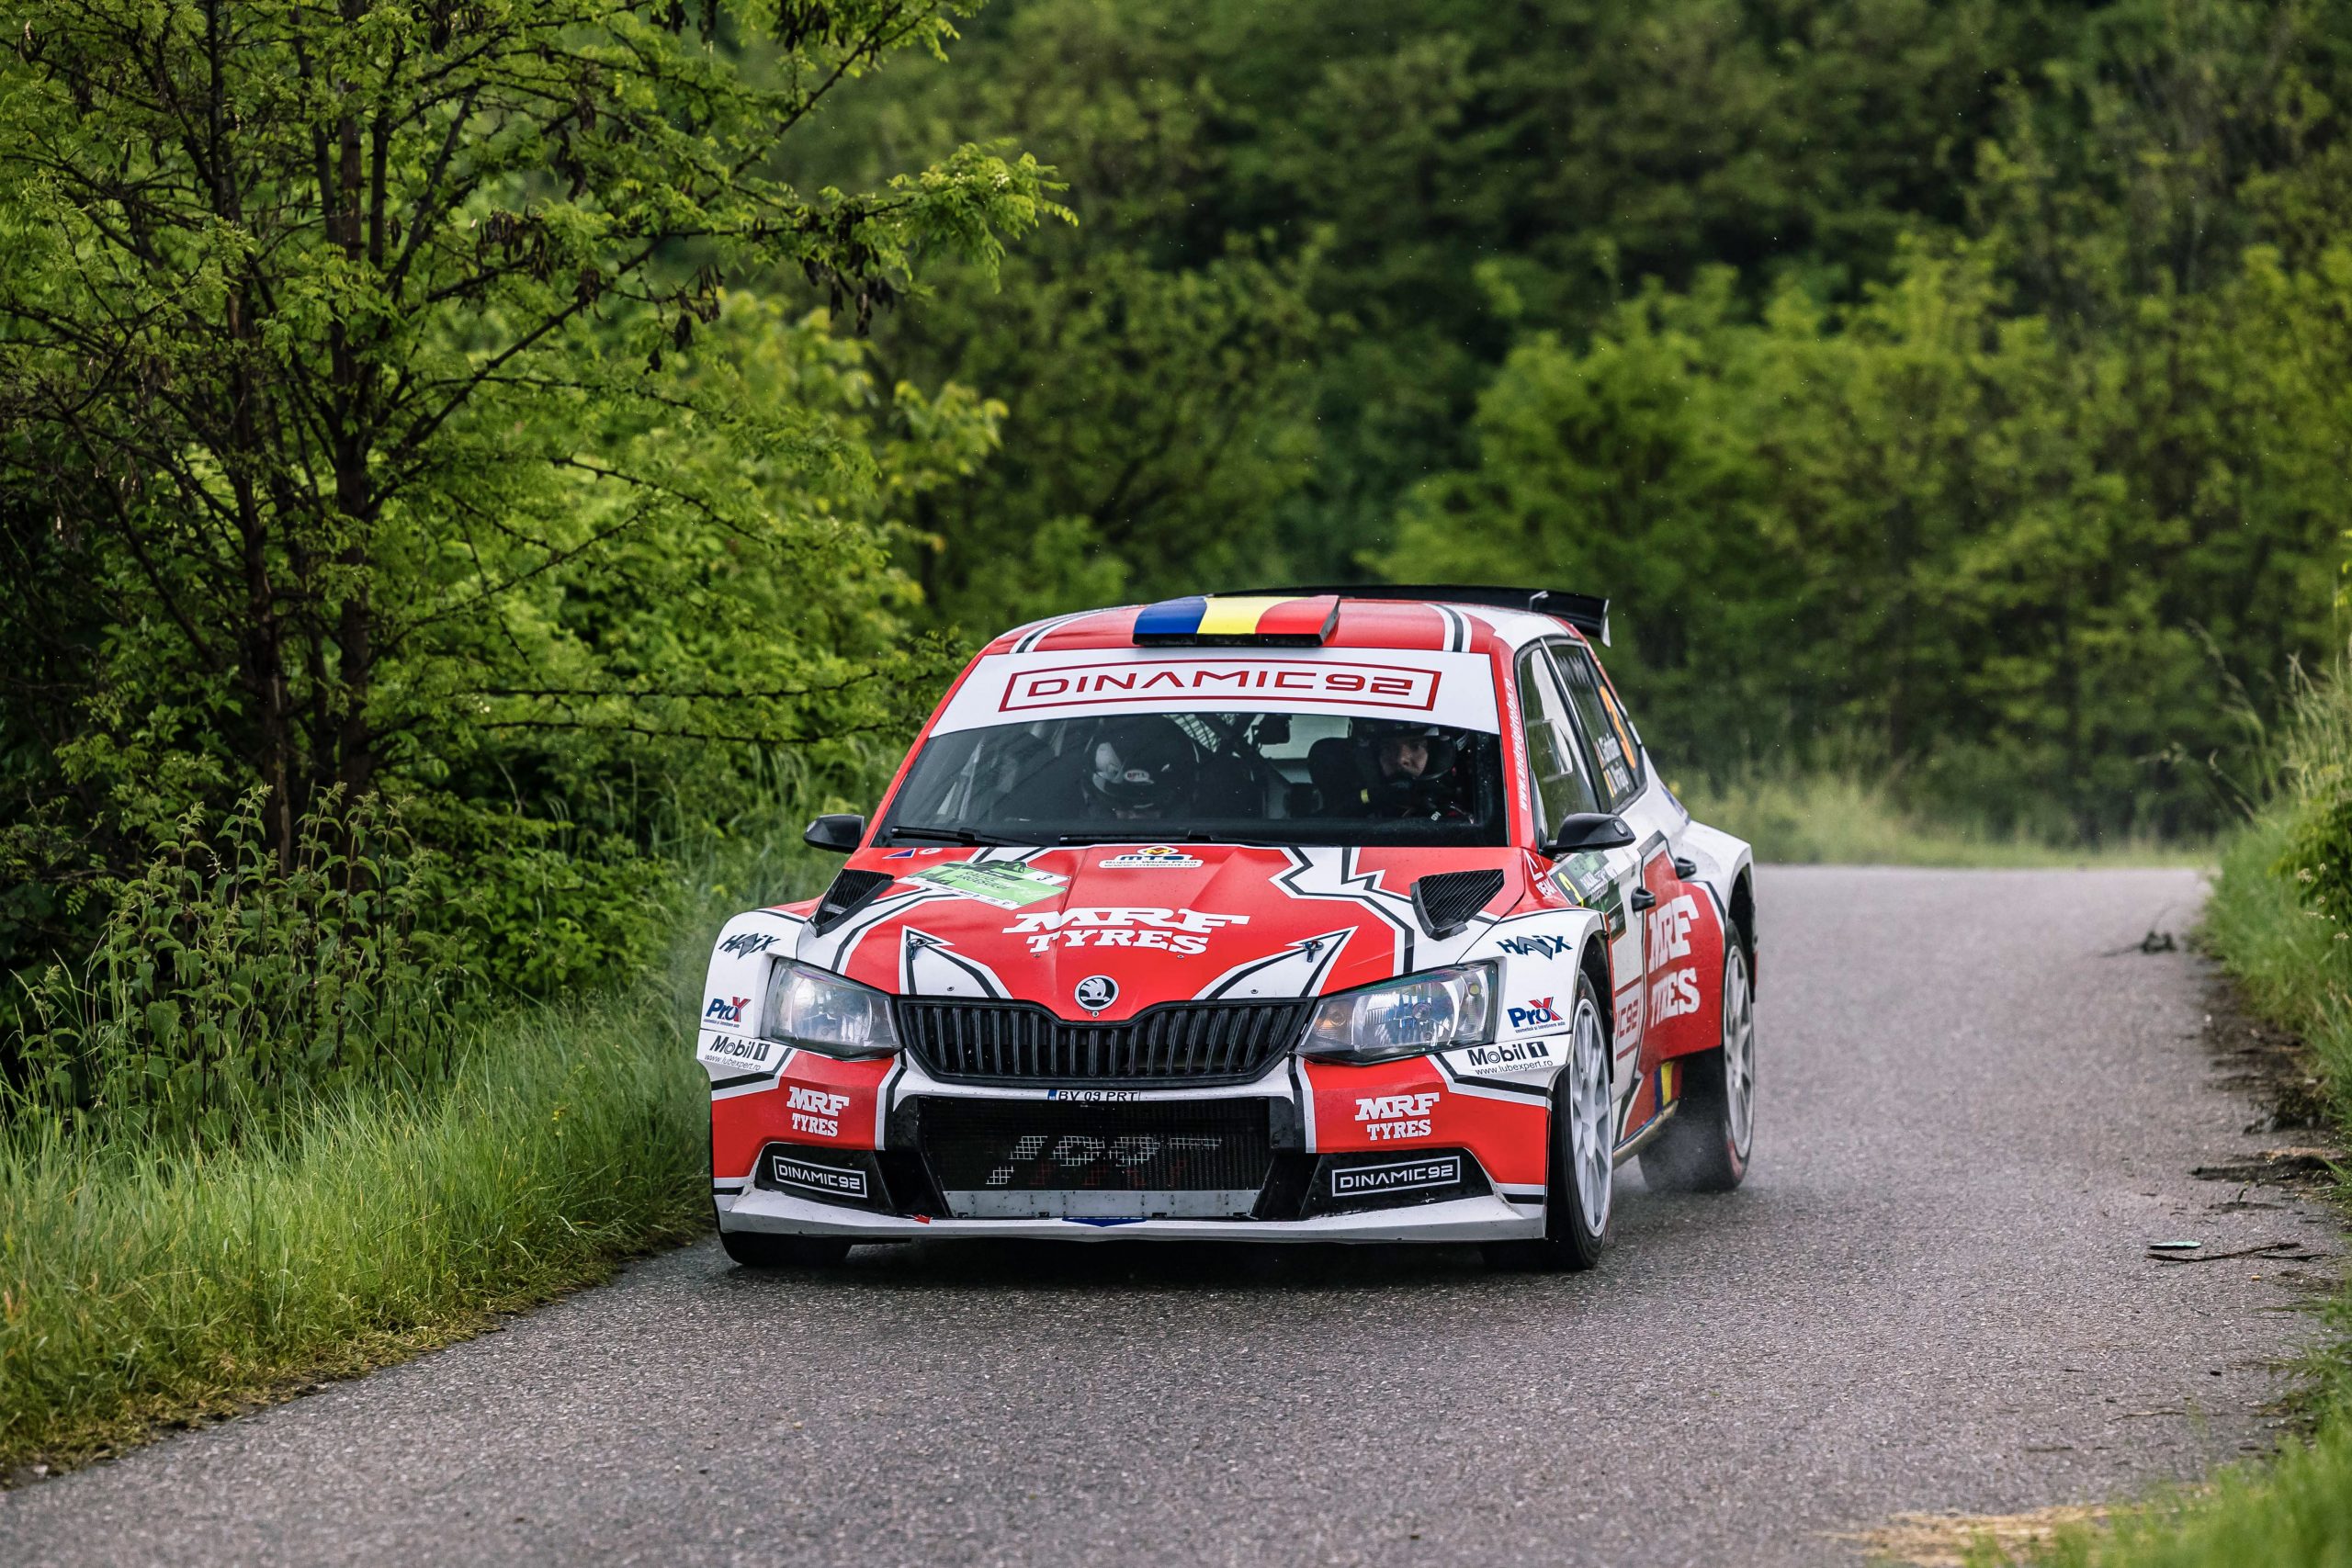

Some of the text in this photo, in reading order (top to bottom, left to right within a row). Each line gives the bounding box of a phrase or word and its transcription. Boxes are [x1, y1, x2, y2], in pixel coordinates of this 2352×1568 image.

[1026, 671, 1414, 698] DINAMIC92
[1001, 907, 1250, 934] MRF
[1026, 929, 1209, 955] TYRES
[1648, 894, 1700, 974] MRF
[709, 1034, 755, 1060] Mobil
[1467, 1041, 1549, 1066] Mobil 1
[704, 1054, 761, 1072] www.lubexpert.ro
[1475, 1060, 1554, 1076] www.lubexpert.ro
[786, 1086, 850, 1117] MRF
[1058, 1090, 1138, 1101] BV 09 PRT
[1354, 1091, 1440, 1122] MRF
[792, 1112, 838, 1137] TYRES
[1367, 1119, 1431, 1141] TYRES
[778, 1164, 861, 1190] DINAMIC92
[1340, 1164, 1453, 1189] DINAMIC92
